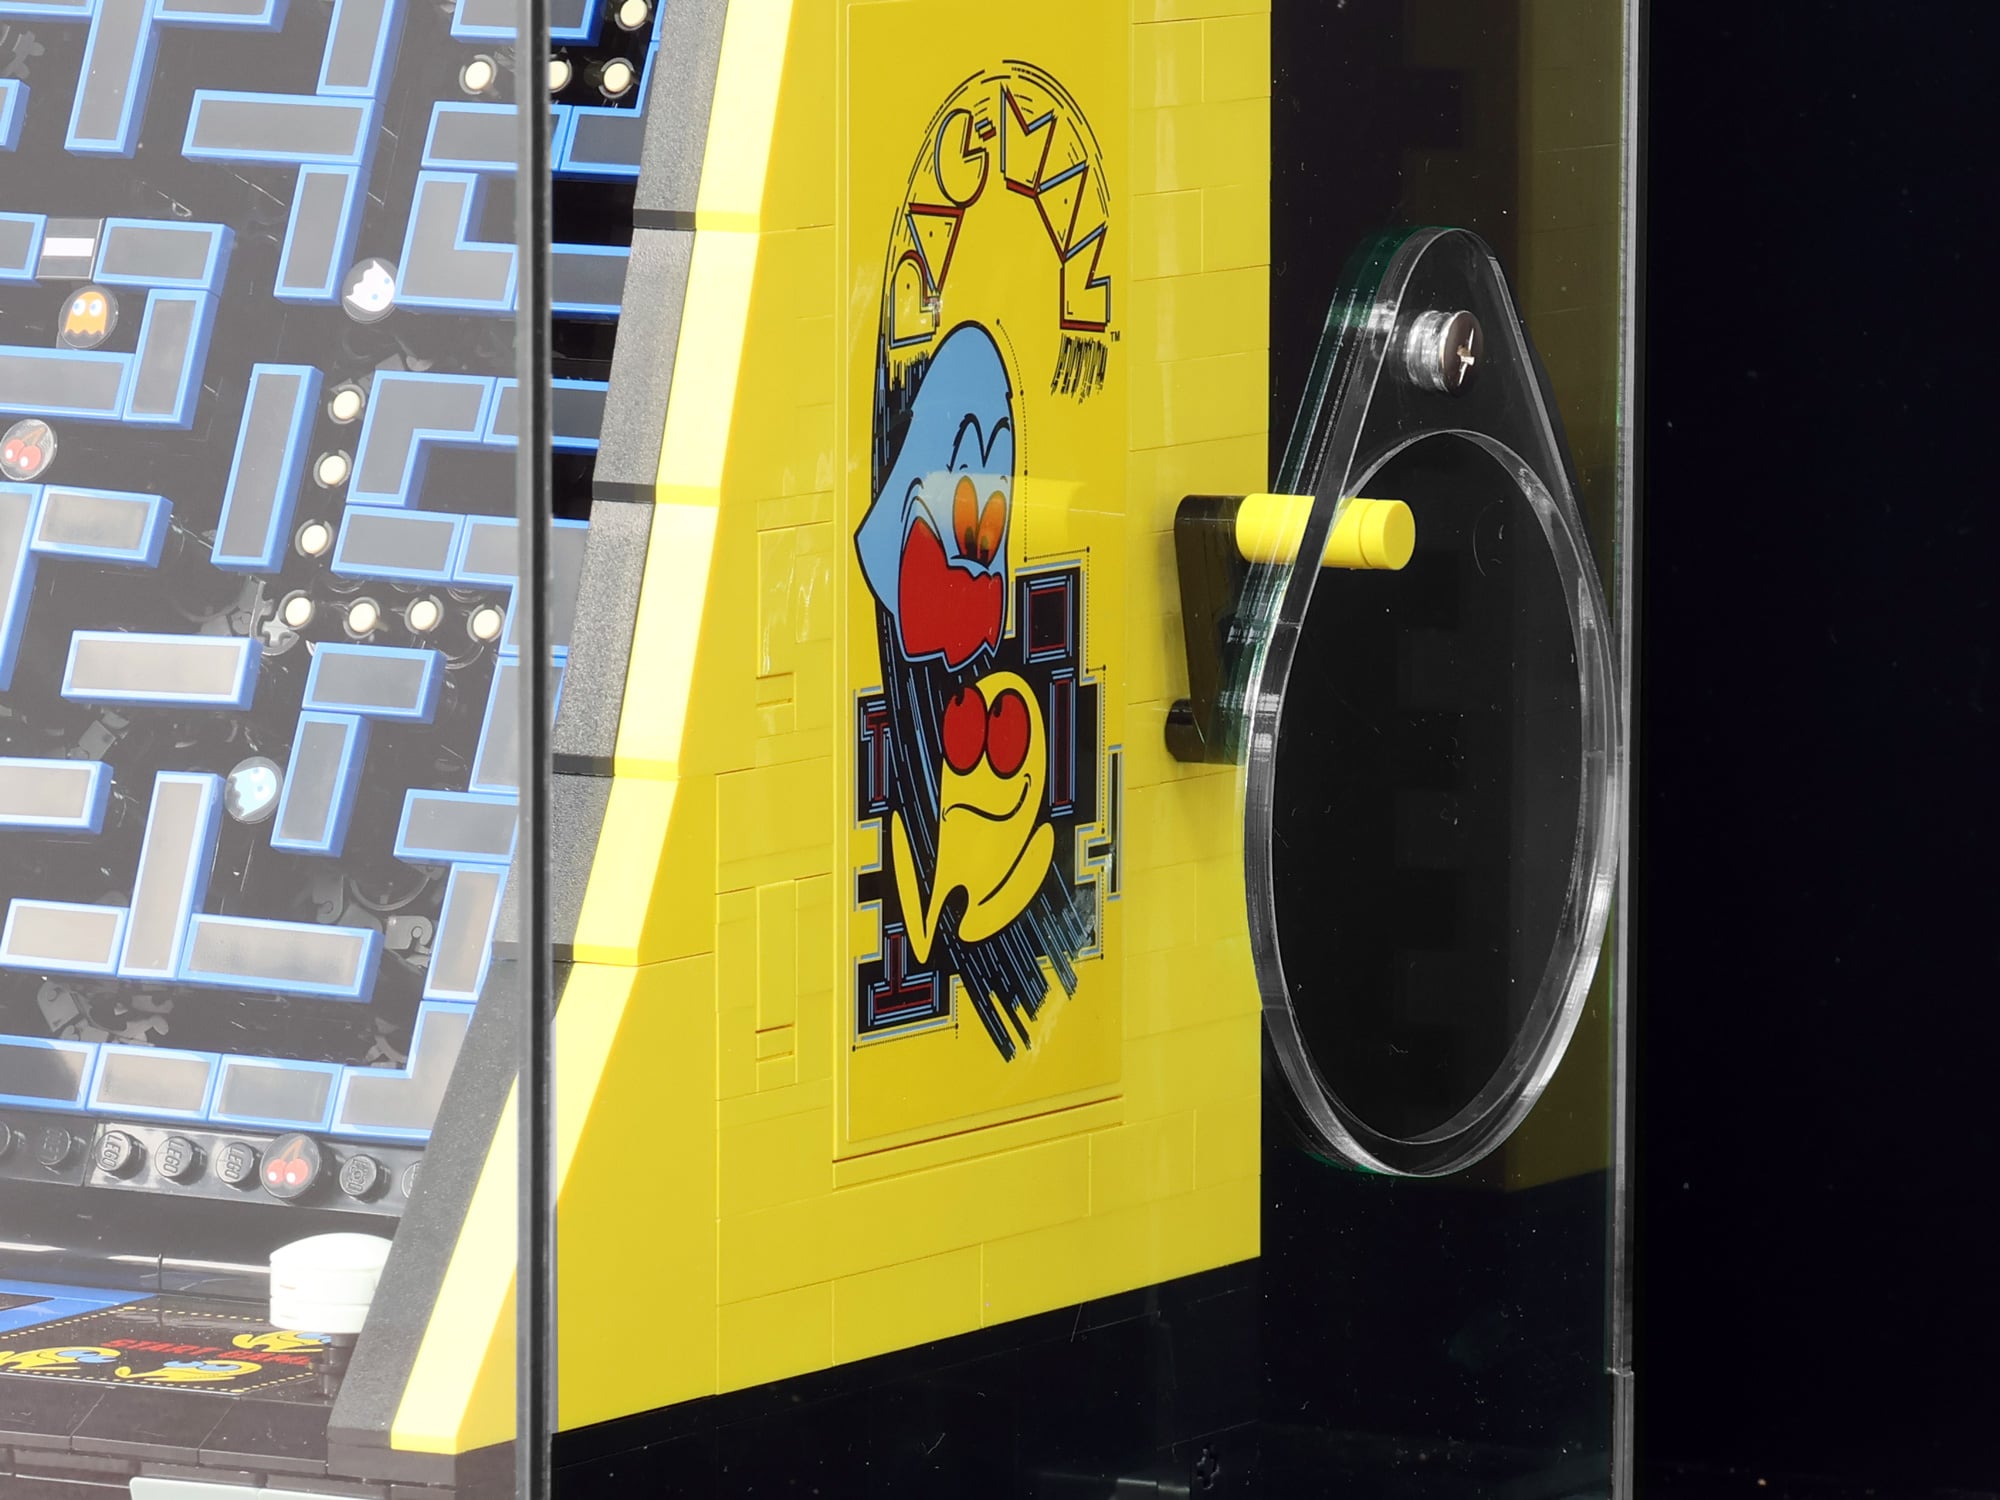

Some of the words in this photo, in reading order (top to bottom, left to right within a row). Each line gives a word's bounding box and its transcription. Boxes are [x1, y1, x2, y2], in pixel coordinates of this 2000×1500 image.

[889, 83, 1111, 350] PAC-MAN
[1110, 330, 1121, 342] TM
[102, 1134, 122, 1168] LEGO
[163, 1140, 184, 1174] LEGO
[224, 1145, 246, 1180] LEGO
[101, 1338, 219, 1356] START
